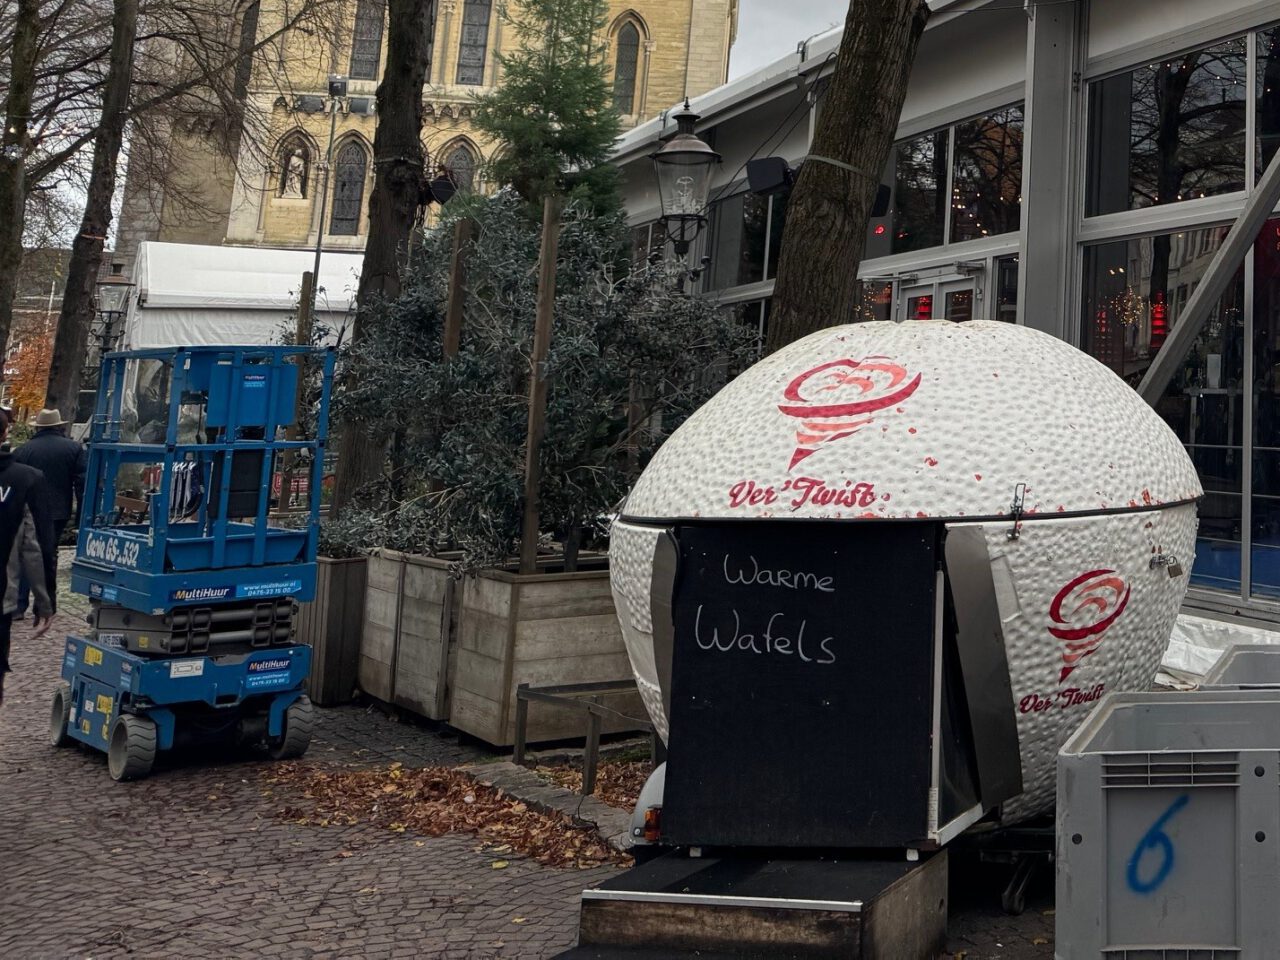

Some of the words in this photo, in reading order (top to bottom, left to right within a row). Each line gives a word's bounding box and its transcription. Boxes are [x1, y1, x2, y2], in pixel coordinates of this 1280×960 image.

[174, 587, 230, 600] MultiHuur
[695, 604, 836, 664] Wafels
[249, 660, 290, 671] MultiHuur
[1126, 794, 1190, 894] 6
